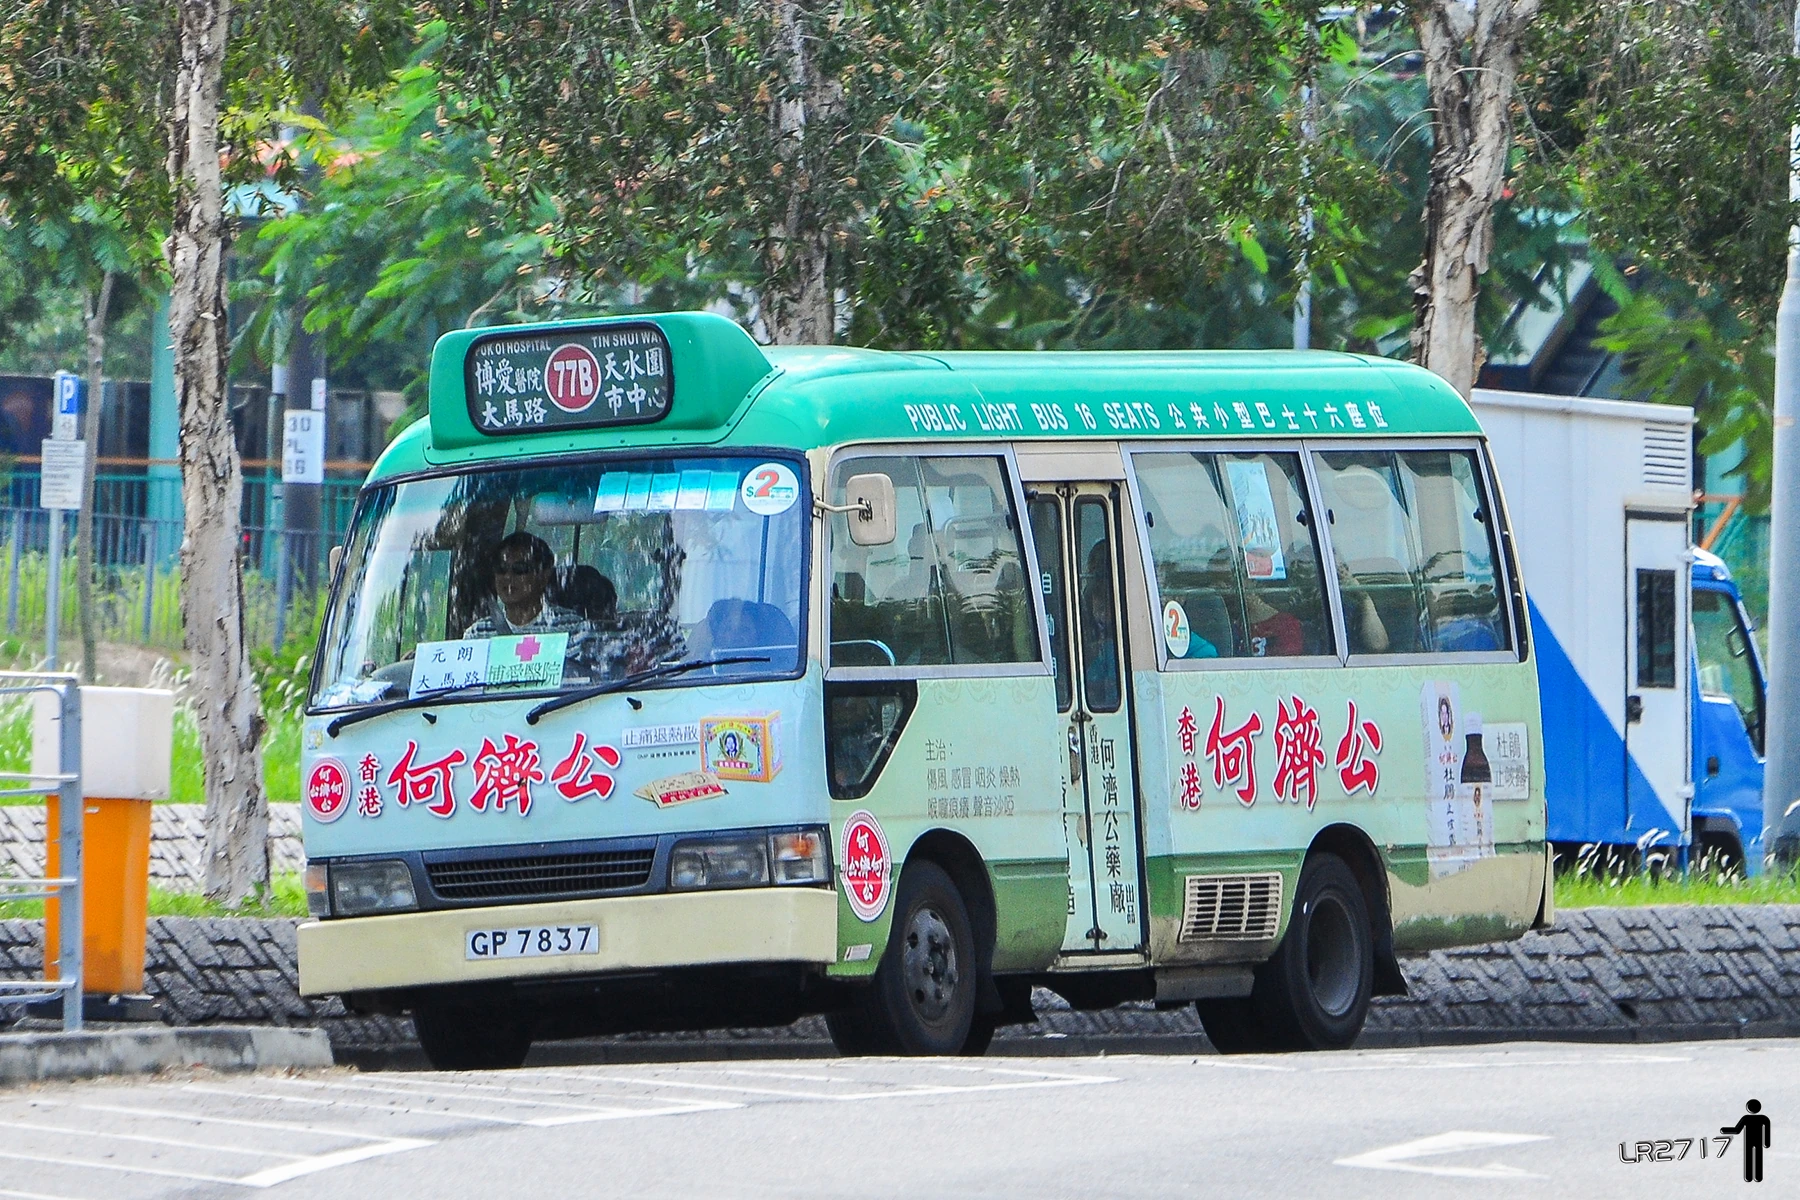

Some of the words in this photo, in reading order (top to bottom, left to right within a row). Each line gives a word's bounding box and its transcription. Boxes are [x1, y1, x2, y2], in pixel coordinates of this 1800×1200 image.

[507, 339, 551, 354] HOSPITAL
[592, 335, 610, 348] TIN
[613, 333, 639, 347] SHUI
[475, 358, 543, 395] 博愛醫院
[553, 359, 594, 398] 77B
[604, 347, 665, 381] 天水圍
[482, 397, 548, 427] 大馬路
[604, 382, 667, 416] 市中心
[904, 403, 967, 432] PUBLIC
[971, 403, 1019, 432] LIGHT
[1031, 403, 1069, 431] BUS
[1074, 402, 1098, 431] 16
[1105, 402, 1161, 431] SEATS
[430, 646, 474, 664] 元朗
[416, 670, 480, 690] 大馬路
[624, 725, 699, 746] 止痛退熱散
[1176, 705, 1203, 811] 香港
[1204, 693, 1384, 815] 何濟公
[358, 752, 383, 818] 香港
[386, 733, 622, 819] 何濟公
[471, 931, 507, 956] GP
[517, 927, 591, 954] 7837
